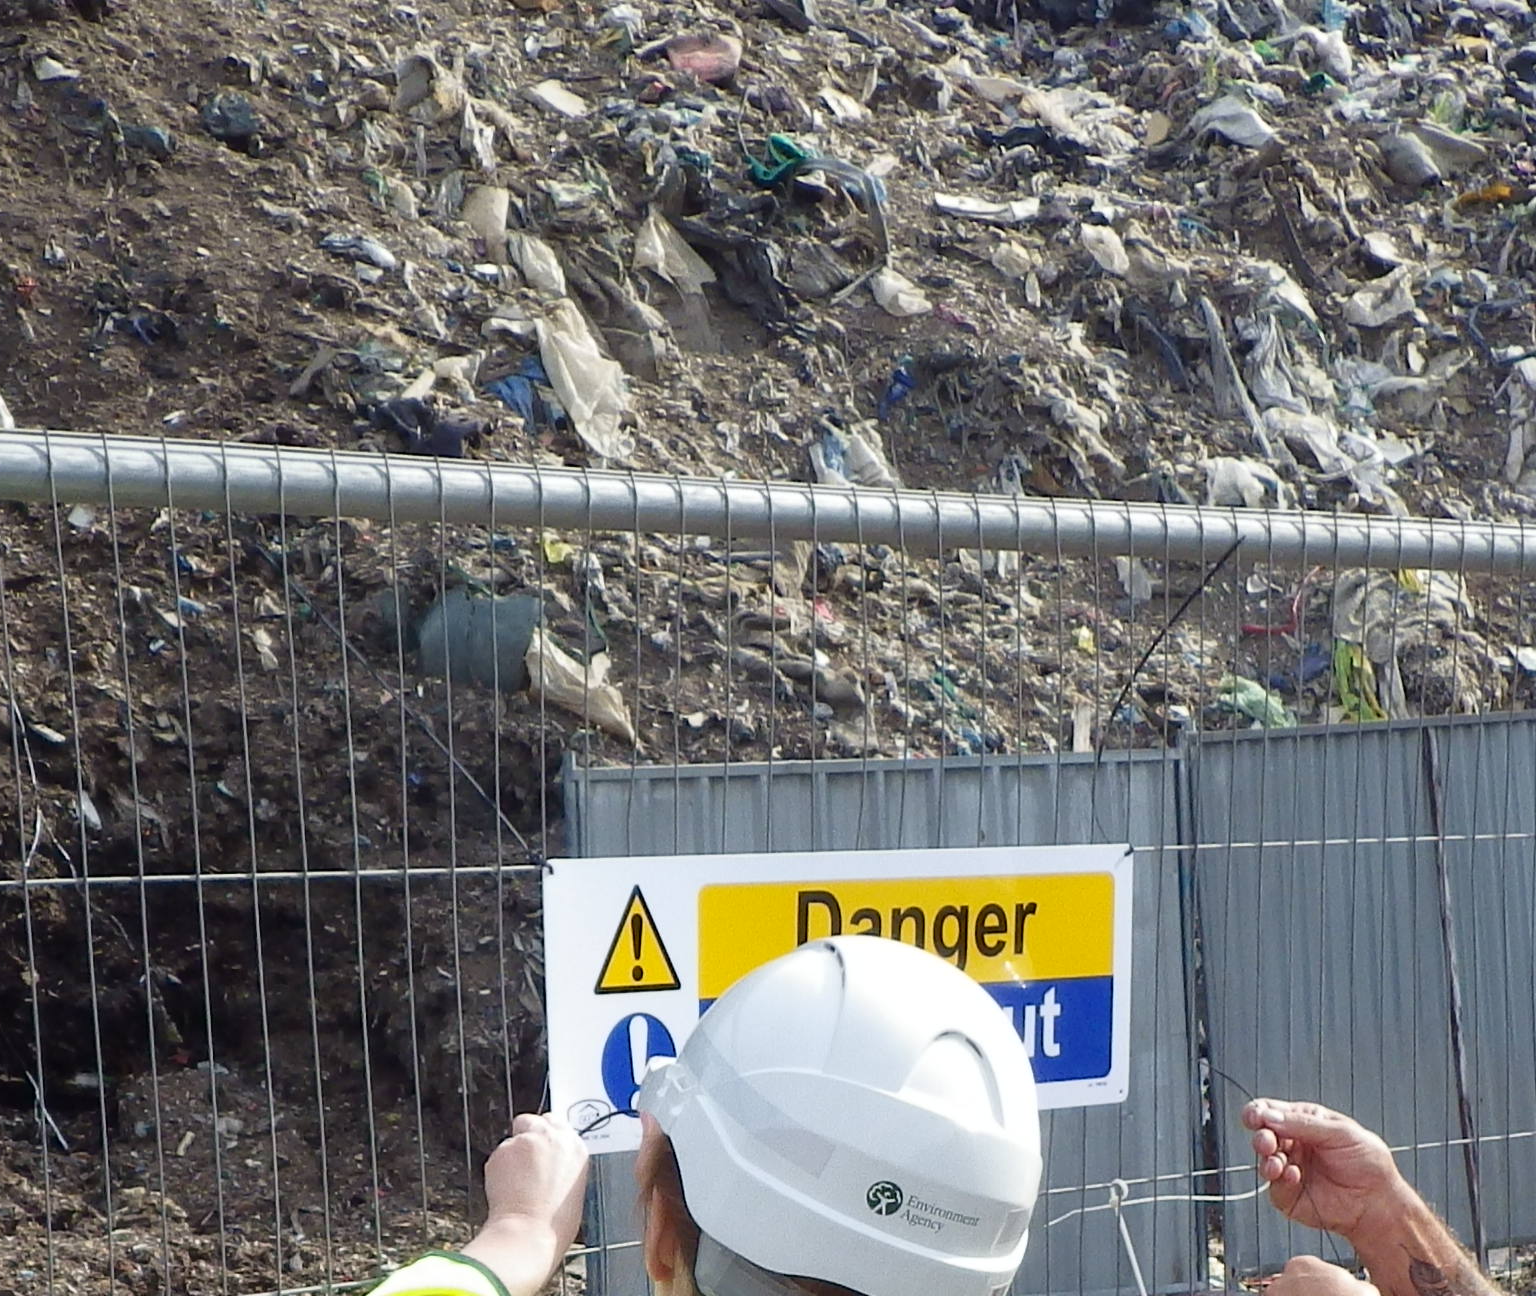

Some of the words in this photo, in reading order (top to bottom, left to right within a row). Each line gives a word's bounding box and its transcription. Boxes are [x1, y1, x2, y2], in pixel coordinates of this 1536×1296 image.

[797, 890, 1037, 971] Danger
[900, 1209, 944, 1234] Agency
[907, 1195, 980, 1227] Environment
